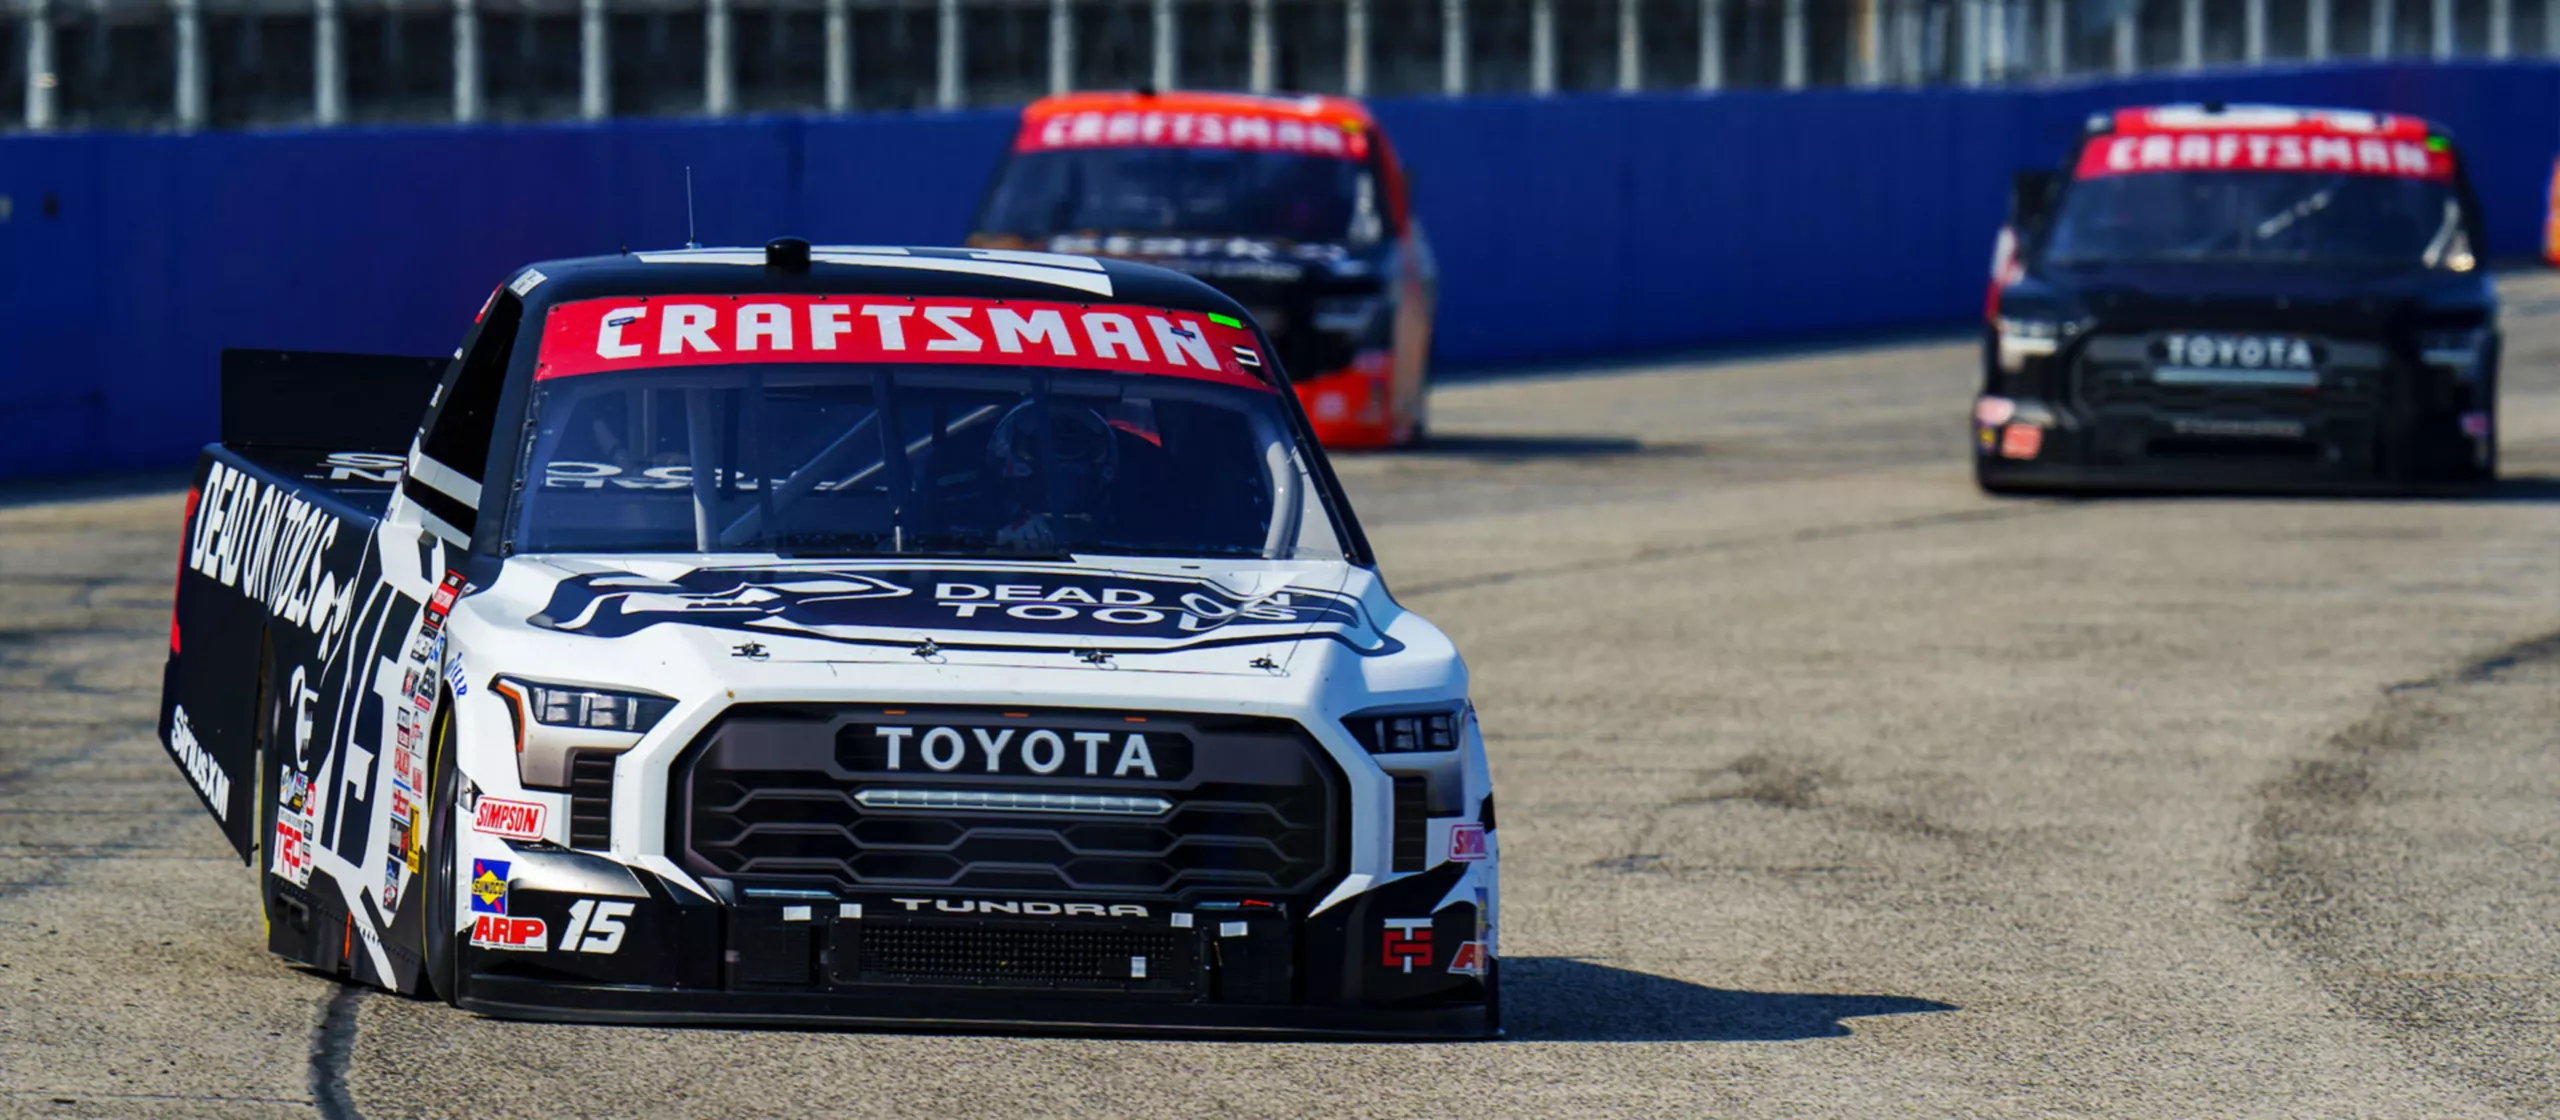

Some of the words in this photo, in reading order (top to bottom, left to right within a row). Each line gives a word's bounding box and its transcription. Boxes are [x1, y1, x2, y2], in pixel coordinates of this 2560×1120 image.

[1041, 111, 1342, 152] CRAFTSMAN
[2107, 134, 2430, 174] CRAFTSMAN
[596, 303, 1221, 372] CRAFTSMAN
[2167, 334, 2313, 369] TOYOTA
[190, 461, 258, 588] DEAD
[243, 483, 289, 603] ON
[268, 497, 340, 629] TOOLS
[934, 582, 1155, 606] DEAD
[938, 602, 1298, 632] TOOLS
[170, 704, 230, 823] SiriusXM
[875, 726, 1158, 778] TOYOTA
[476, 802, 539, 833] SIMPSON
[472, 879, 506, 897] SUNOCO
[891, 898, 1149, 917] TUNDRA
[473, 915, 545, 945] ARP
[559, 899, 635, 954] 15
